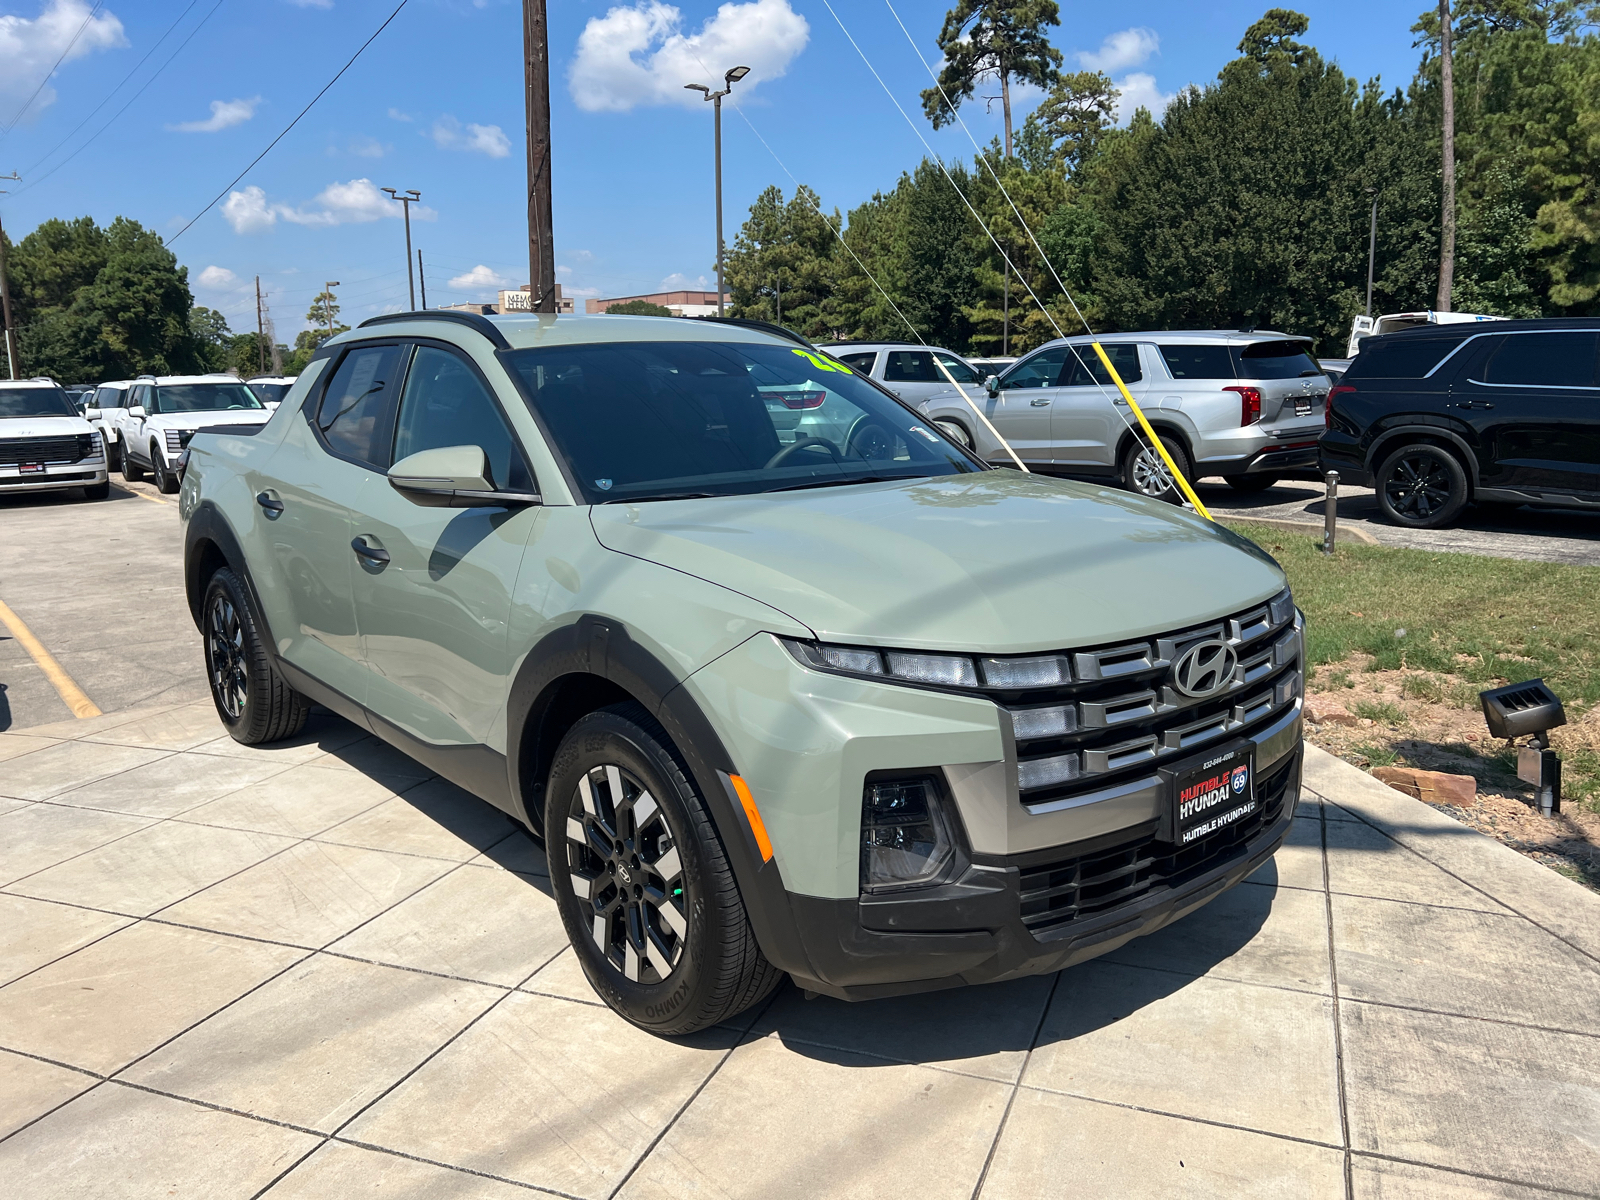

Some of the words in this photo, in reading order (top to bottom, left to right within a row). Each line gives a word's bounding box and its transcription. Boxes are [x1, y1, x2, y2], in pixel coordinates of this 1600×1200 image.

[1180, 771, 1230, 804] HUMBLE
[1233, 774, 1246, 789] 69
[1180, 784, 1230, 820] HYUNDAI
[1182, 820, 1217, 843] HUMBLE
[1217, 803, 1251, 827] HYUNDAI
[645, 980, 690, 1018] KUMHO
